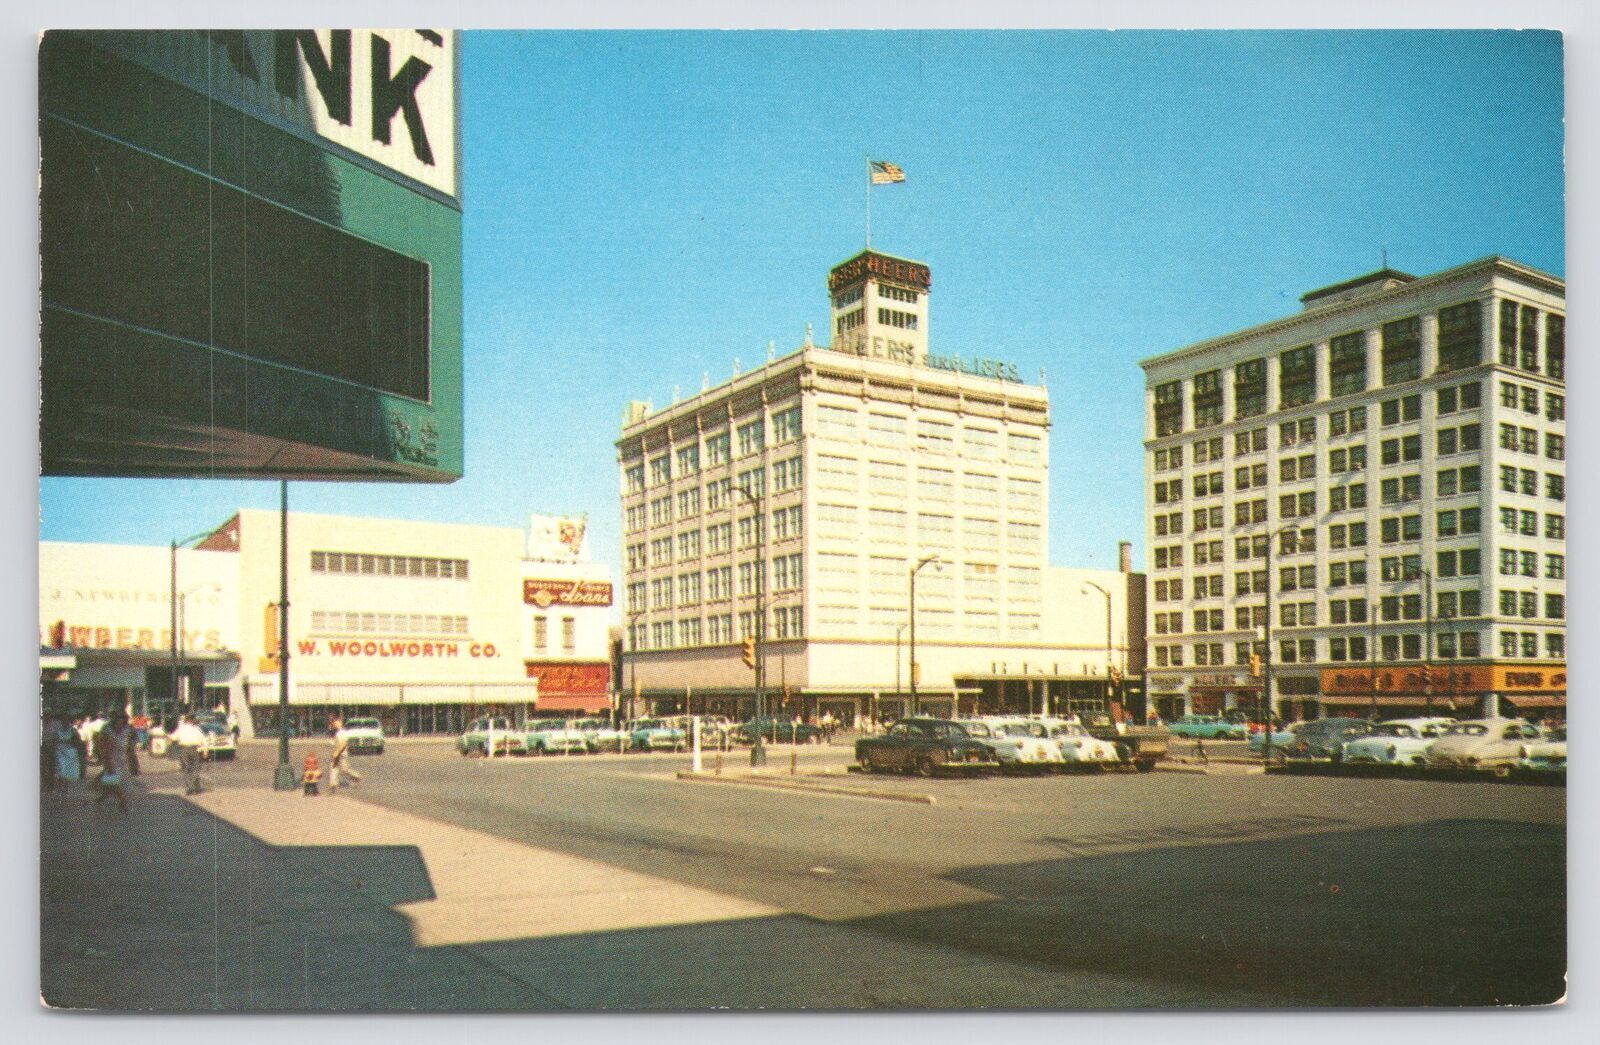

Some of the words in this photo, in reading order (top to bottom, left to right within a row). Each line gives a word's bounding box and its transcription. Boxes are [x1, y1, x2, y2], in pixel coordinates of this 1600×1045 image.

[867, 257, 931, 284] HEERS
[328, 641, 459, 657] WOOLWORTH
[470, 642, 501, 658] CO.
